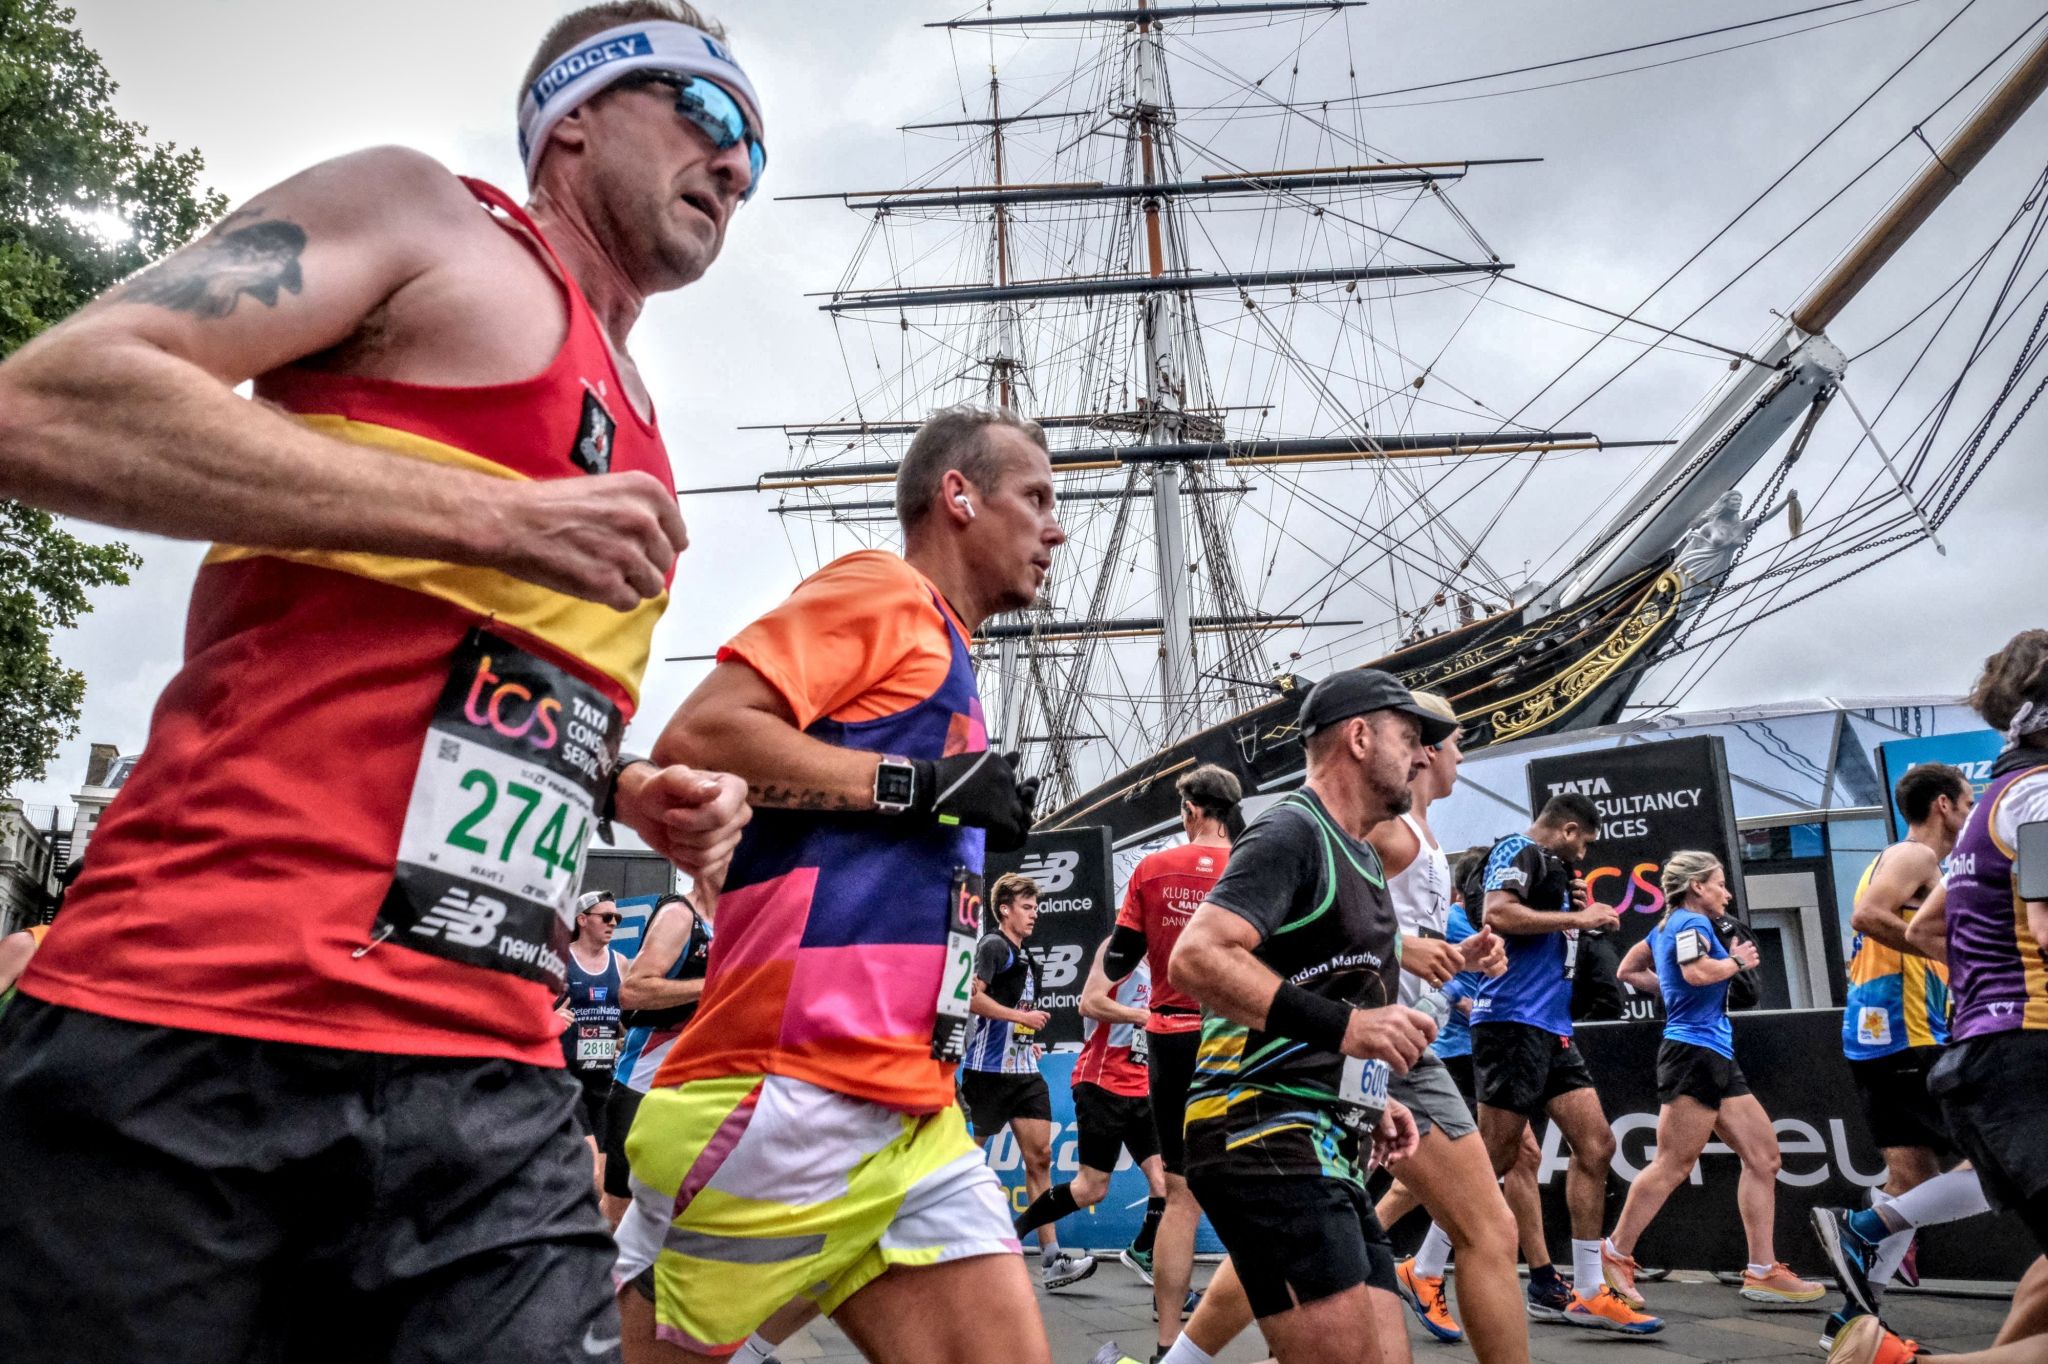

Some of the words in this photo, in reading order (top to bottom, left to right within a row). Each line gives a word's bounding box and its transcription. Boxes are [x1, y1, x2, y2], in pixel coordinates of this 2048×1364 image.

[1443, 648, 1488, 675] SARK
[464, 656, 563, 750] tcs
[573, 697, 609, 735] TATA
[1547, 777, 1612, 797] TATA
[1594, 788, 1702, 817] SULTANCY
[445, 768, 588, 890] 2744
[1178, 900, 1199, 910] MAR
[1574, 862, 1665, 915] cs
[499, 935, 540, 963] new
[953, 951, 972, 1001] 2
[1290, 963, 1329, 985] ndon
[1331, 951, 1382, 969] Marathon
